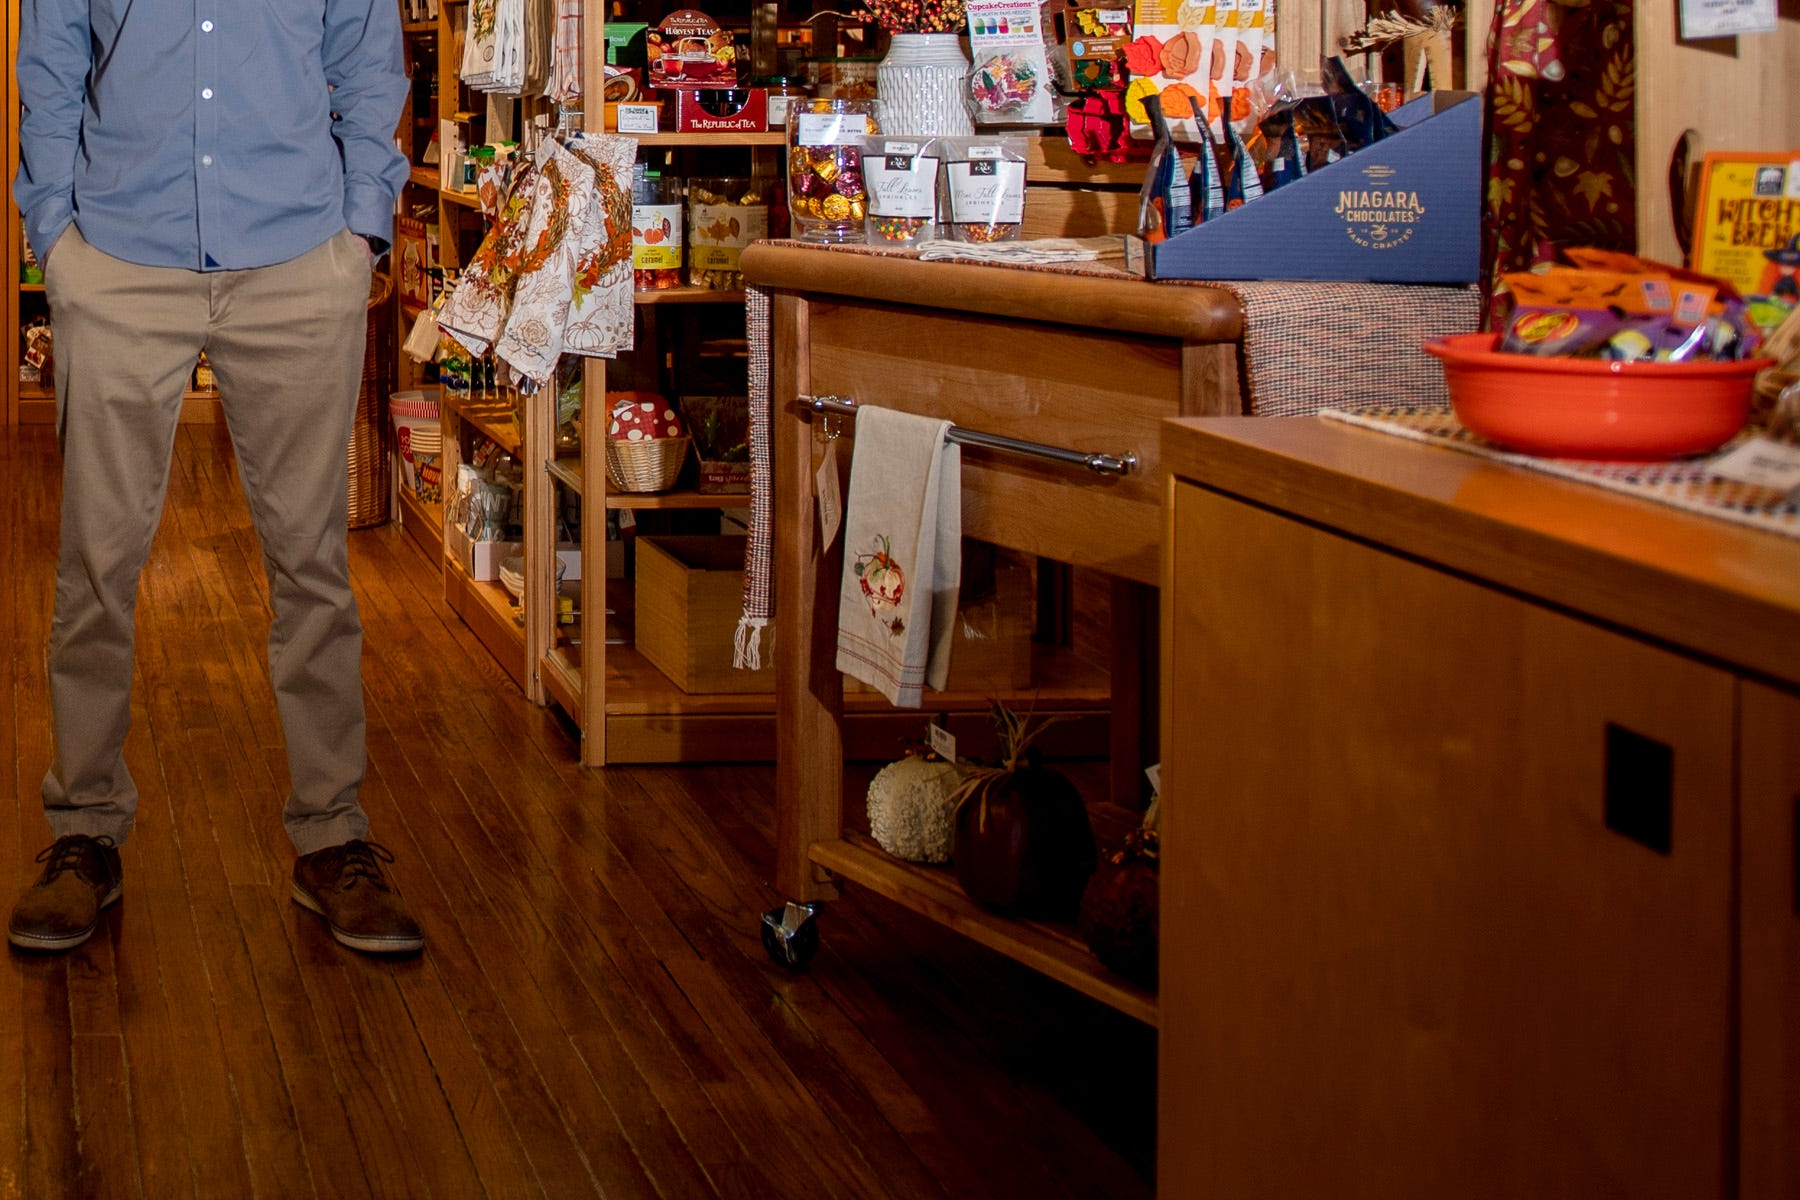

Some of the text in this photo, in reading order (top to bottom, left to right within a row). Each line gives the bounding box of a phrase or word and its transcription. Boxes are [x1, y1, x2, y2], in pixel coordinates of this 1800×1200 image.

[696, 27, 715, 35] TEAS
[702, 119, 735, 129] REPUBLIC
[742, 119, 756, 129] TEA
[1335, 190, 1426, 214] NIAGARA
[1346, 210, 1415, 223] CHOCOLATES
[1346, 227, 1414, 249] HAND CRAFTED
[641, 255, 664, 264] caramel
